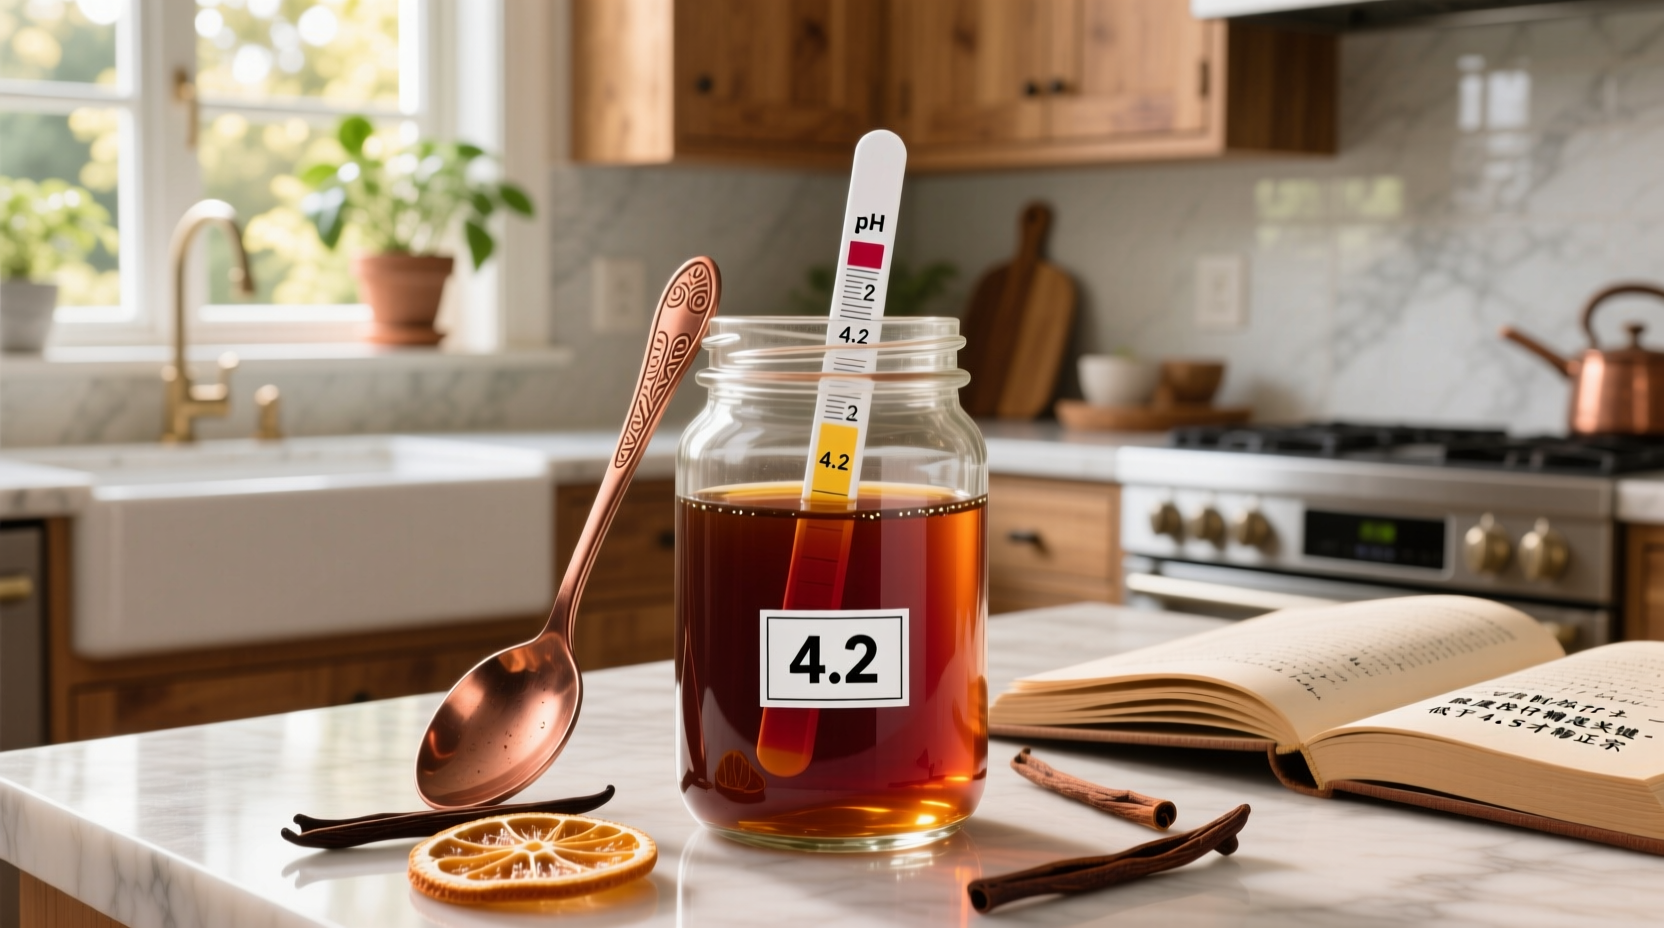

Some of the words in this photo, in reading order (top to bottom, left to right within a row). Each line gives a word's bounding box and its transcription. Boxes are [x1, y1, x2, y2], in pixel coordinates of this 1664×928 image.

[854, 213, 886, 234] pH
[863, 284, 876, 302] 2
[838, 326, 870, 345] 4.2
[845, 405, 859, 422] 2
[819, 451, 850, 471] 4.2
[789, 634, 878, 684] 4.2
